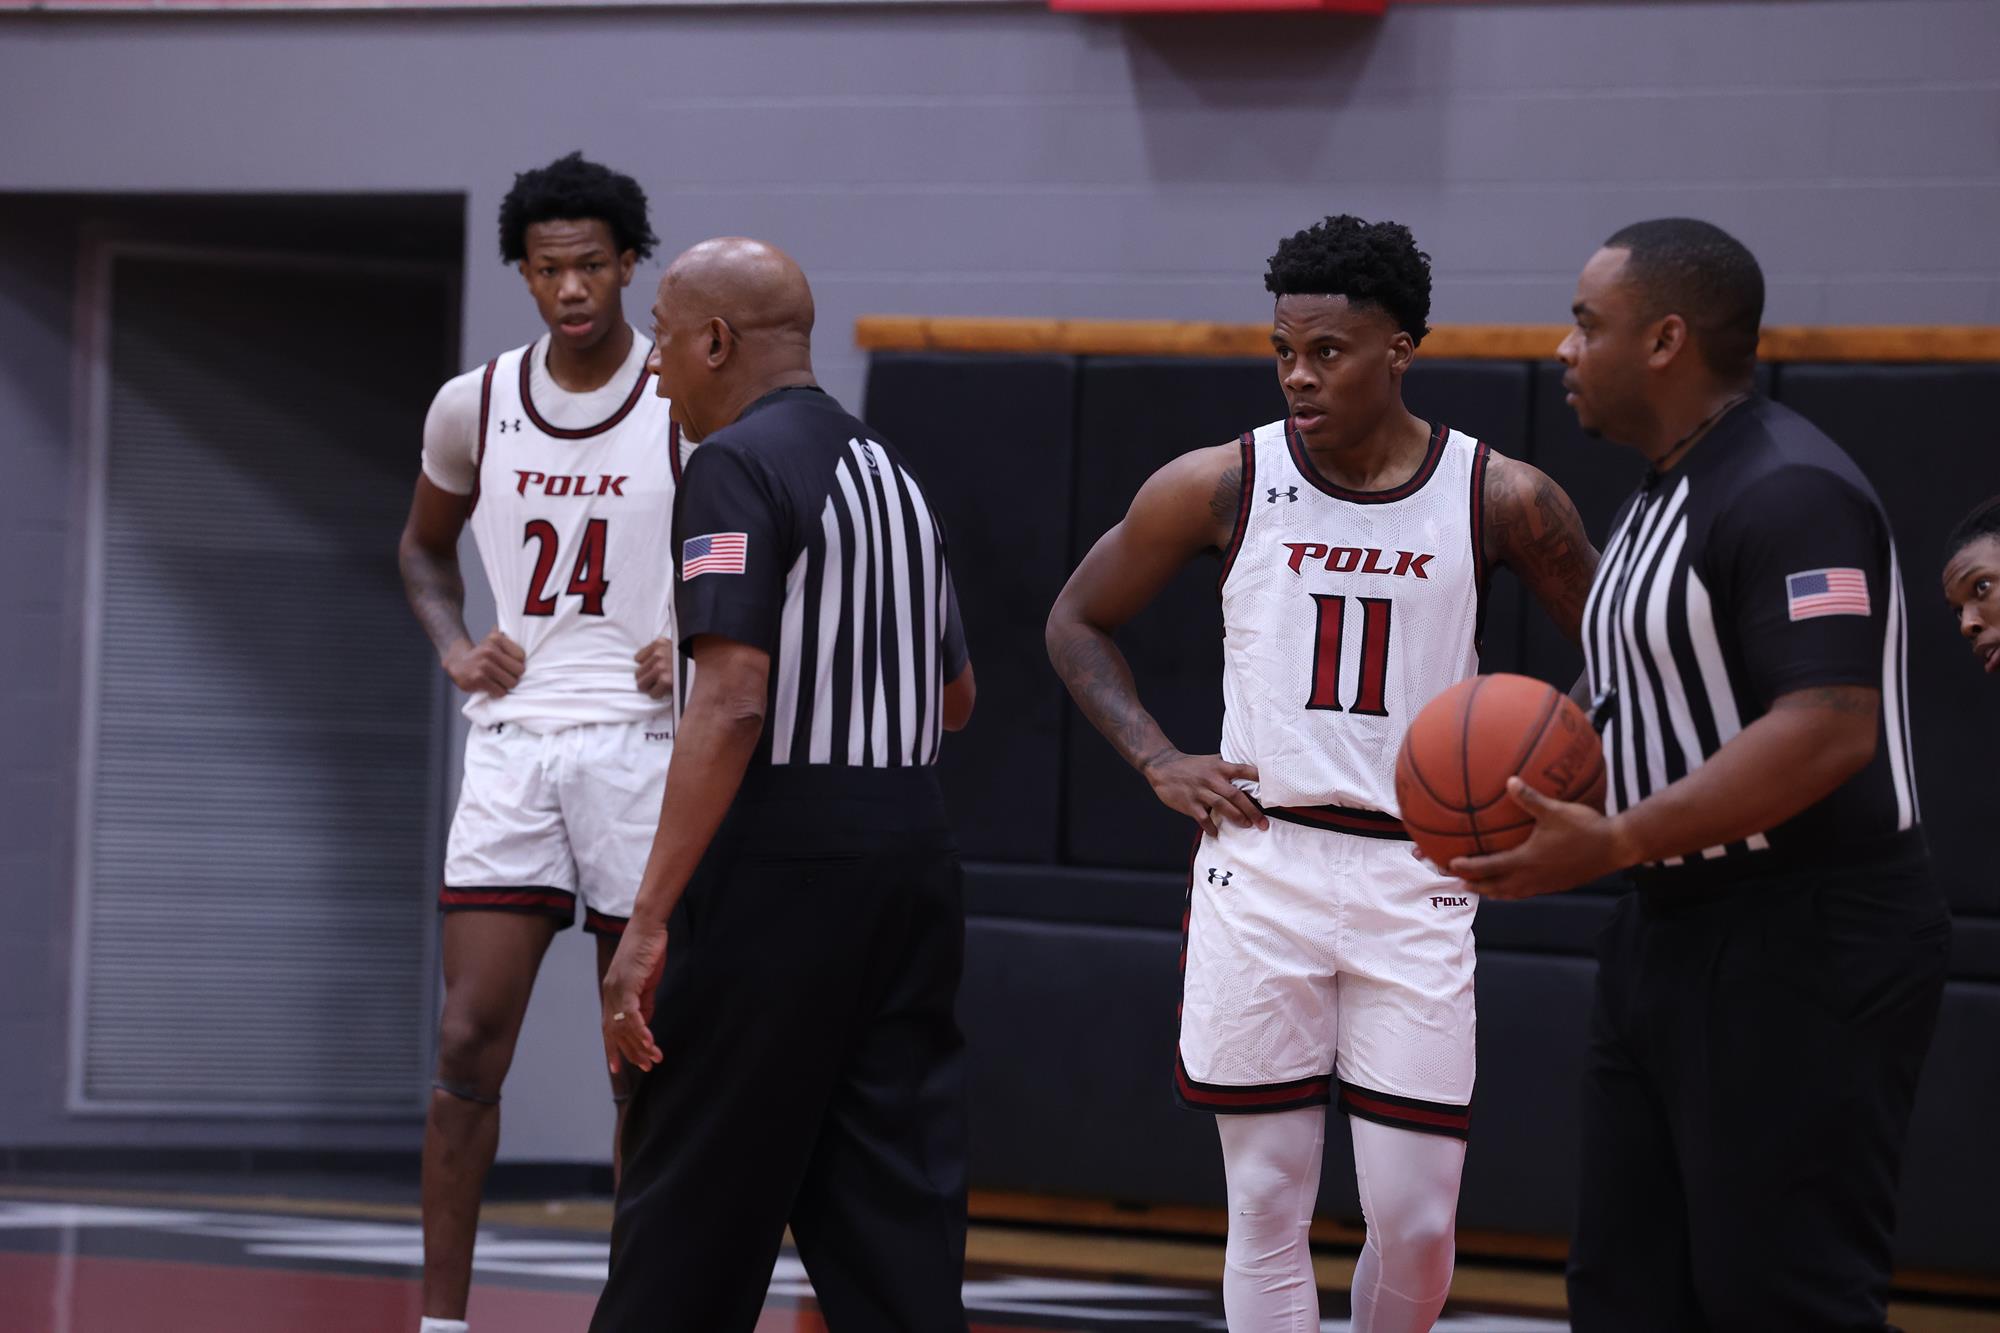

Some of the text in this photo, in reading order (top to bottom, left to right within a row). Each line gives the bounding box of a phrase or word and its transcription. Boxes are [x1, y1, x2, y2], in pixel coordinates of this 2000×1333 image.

[515, 470, 629, 498] POLK
[522, 518, 610, 617] 24
[1282, 542, 1436, 580] POLK
[1305, 593, 1392, 717] 11
[644, 731, 673, 741] POL
[1428, 896, 1469, 909] POLK
